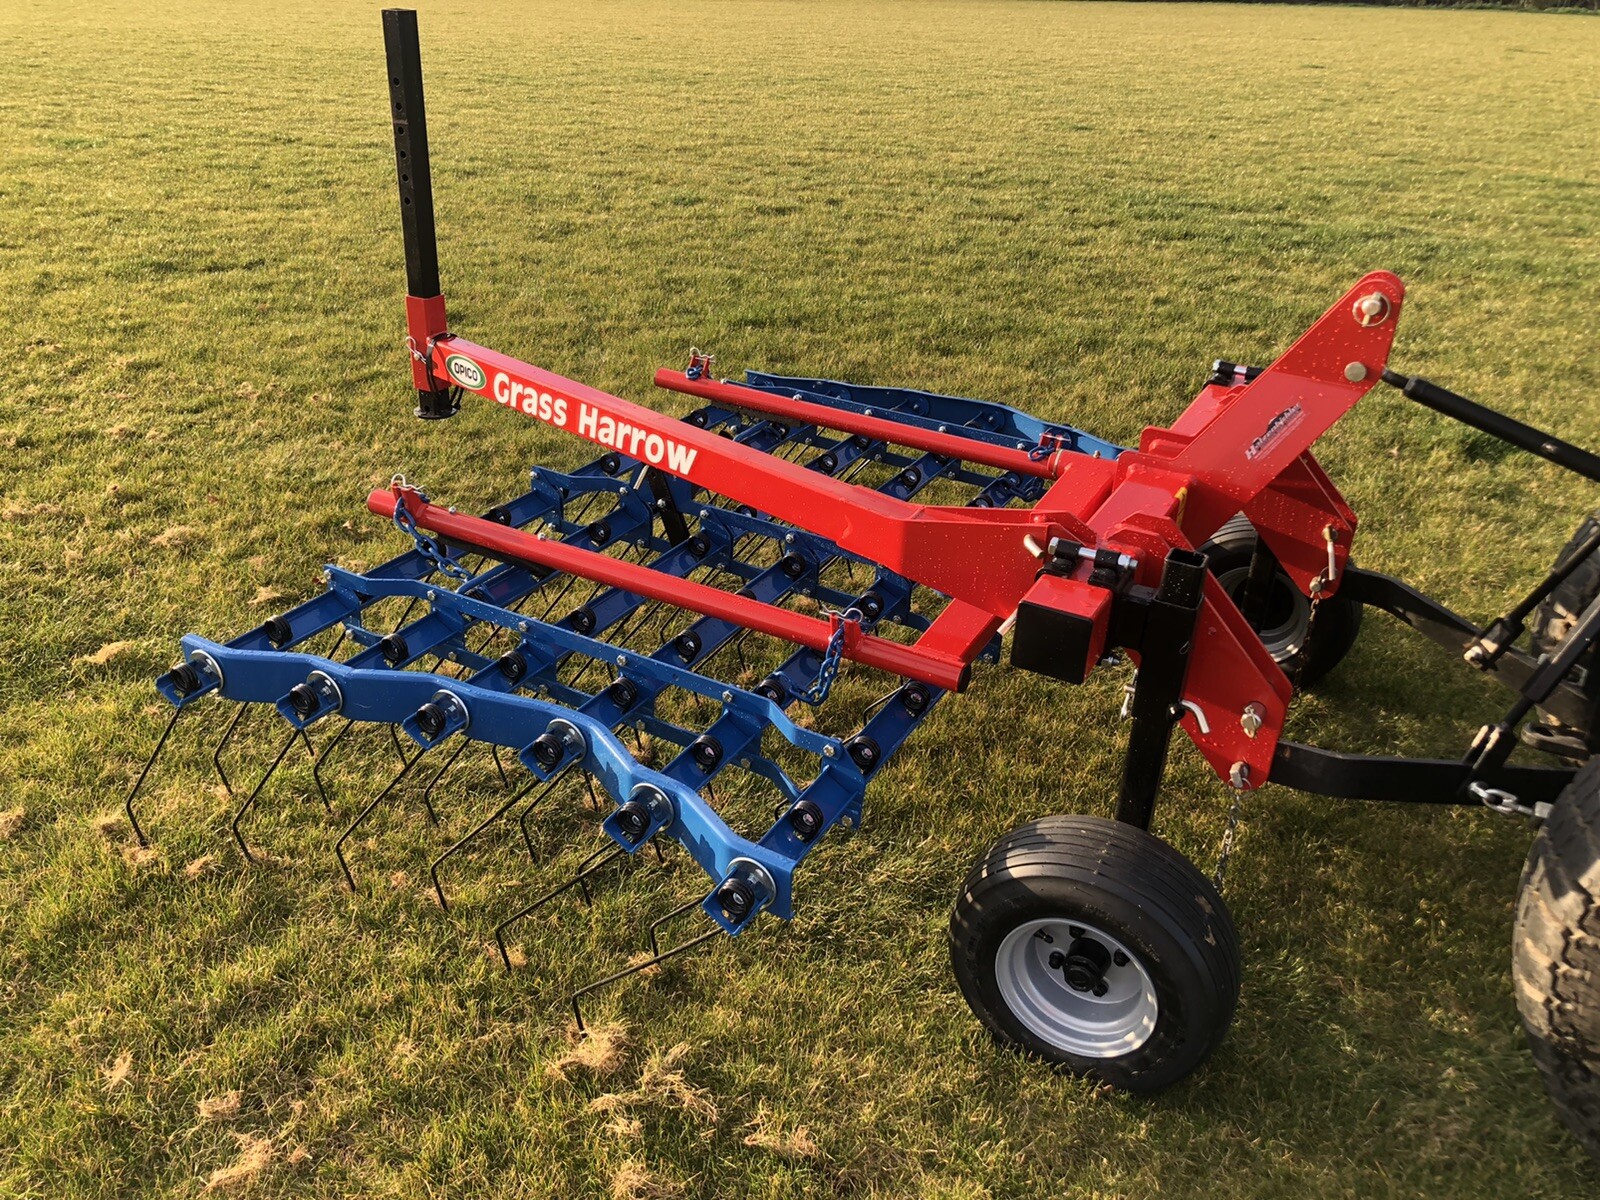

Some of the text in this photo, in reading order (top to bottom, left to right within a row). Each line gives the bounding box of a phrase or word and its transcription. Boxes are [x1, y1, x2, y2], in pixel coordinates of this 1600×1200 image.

[454, 362, 478, 382] OPICO
[493, 372, 697, 475] Grass Harrow
